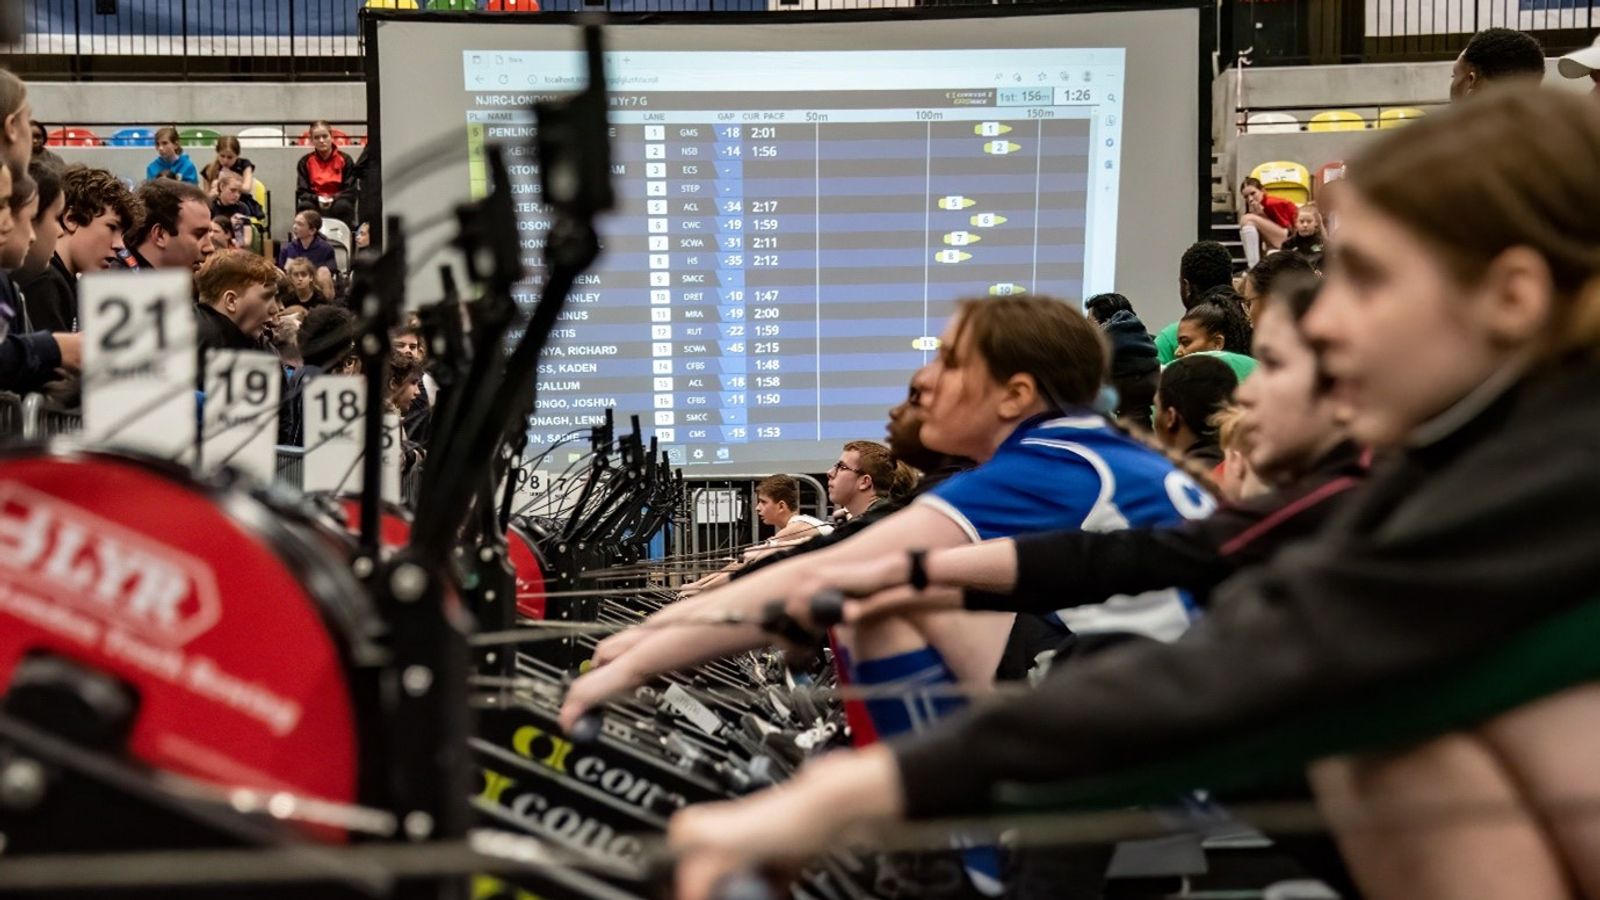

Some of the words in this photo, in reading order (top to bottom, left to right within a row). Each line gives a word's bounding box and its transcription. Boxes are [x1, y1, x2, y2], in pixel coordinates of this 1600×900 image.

[1000, 92, 1016, 102] 1st:
[1022, 91, 1050, 101] 156m
[1064, 89, 1091, 101] 1:26
[632, 97, 638, 106] 7
[640, 97, 648, 106] G
[488, 113, 514, 121] NAME
[643, 113, 666, 121] LANE
[717, 112, 735, 121] GAP
[742, 112, 760, 120] CUR
[764, 112, 785, 120] PACE
[805, 110, 829, 122] 50m
[915, 109, 943, 121] 100m
[1026, 108, 1055, 119] 150m
[680, 129, 699, 137] GMS
[721, 127, 740, 138] -18
[751, 127, 776, 138] 2:01
[722, 146, 741, 157] -14
[752, 146, 777, 157] 1:56
[683, 165, 698, 174] ECS
[681, 184, 701, 193] STEP
[683, 203, 699, 212] ACL
[723, 201, 742, 212] -34
[752, 201, 778, 212] 2:17
[682, 221, 701, 229] CWC
[723, 219, 742, 230] -19
[753, 219, 778, 230] 1:59
[680, 239, 704, 248] SCWA
[724, 237, 741, 248] -31
[753, 237, 777, 248] 2:11
[687, 257, 698, 265] HS
[724, 255, 743, 266] -35
[753, 255, 778, 266] 2:12
[682, 274, 704, 283] SMCC
[566, 293, 601, 302] ANLEY
[656, 293, 666, 301] 10
[725, 291, 744, 301] -10
[754, 290, 779, 301] 1:47
[999, 285, 1011, 295] 10
[726, 308, 744, 319] -19
[753, 307, 779, 319] 2:00
[96, 298, 168, 352] 21
[657, 328, 666, 336] 12
[726, 326, 744, 336] -22
[754, 325, 780, 336] 1:59
[567, 345, 618, 355] RICHARD
[727, 343, 744, 353] -45
[754, 342, 780, 353] 2:15
[558, 362, 597, 373] KADEN
[755, 360, 780, 370] 1:48
[218, 367, 269, 407] 19
[536, 381, 581, 391] CALLUM
[688, 379, 703, 387] ACL
[727, 377, 745, 387] -18
[755, 377, 780, 387] 1:58
[314, 389, 360, 423] 18
[535, 399, 569, 409] ONGO,
[572, 398, 617, 408] JOSHUA
[727, 394, 745, 404] -11
[756, 394, 780, 404] 1:50
[529, 416, 572, 427] ONAGH,
[728, 428, 746, 438] -15
[756, 427, 781, 438] 1:53
[530, 475, 540, 490] 8
[557, 478, 567, 491] 7
